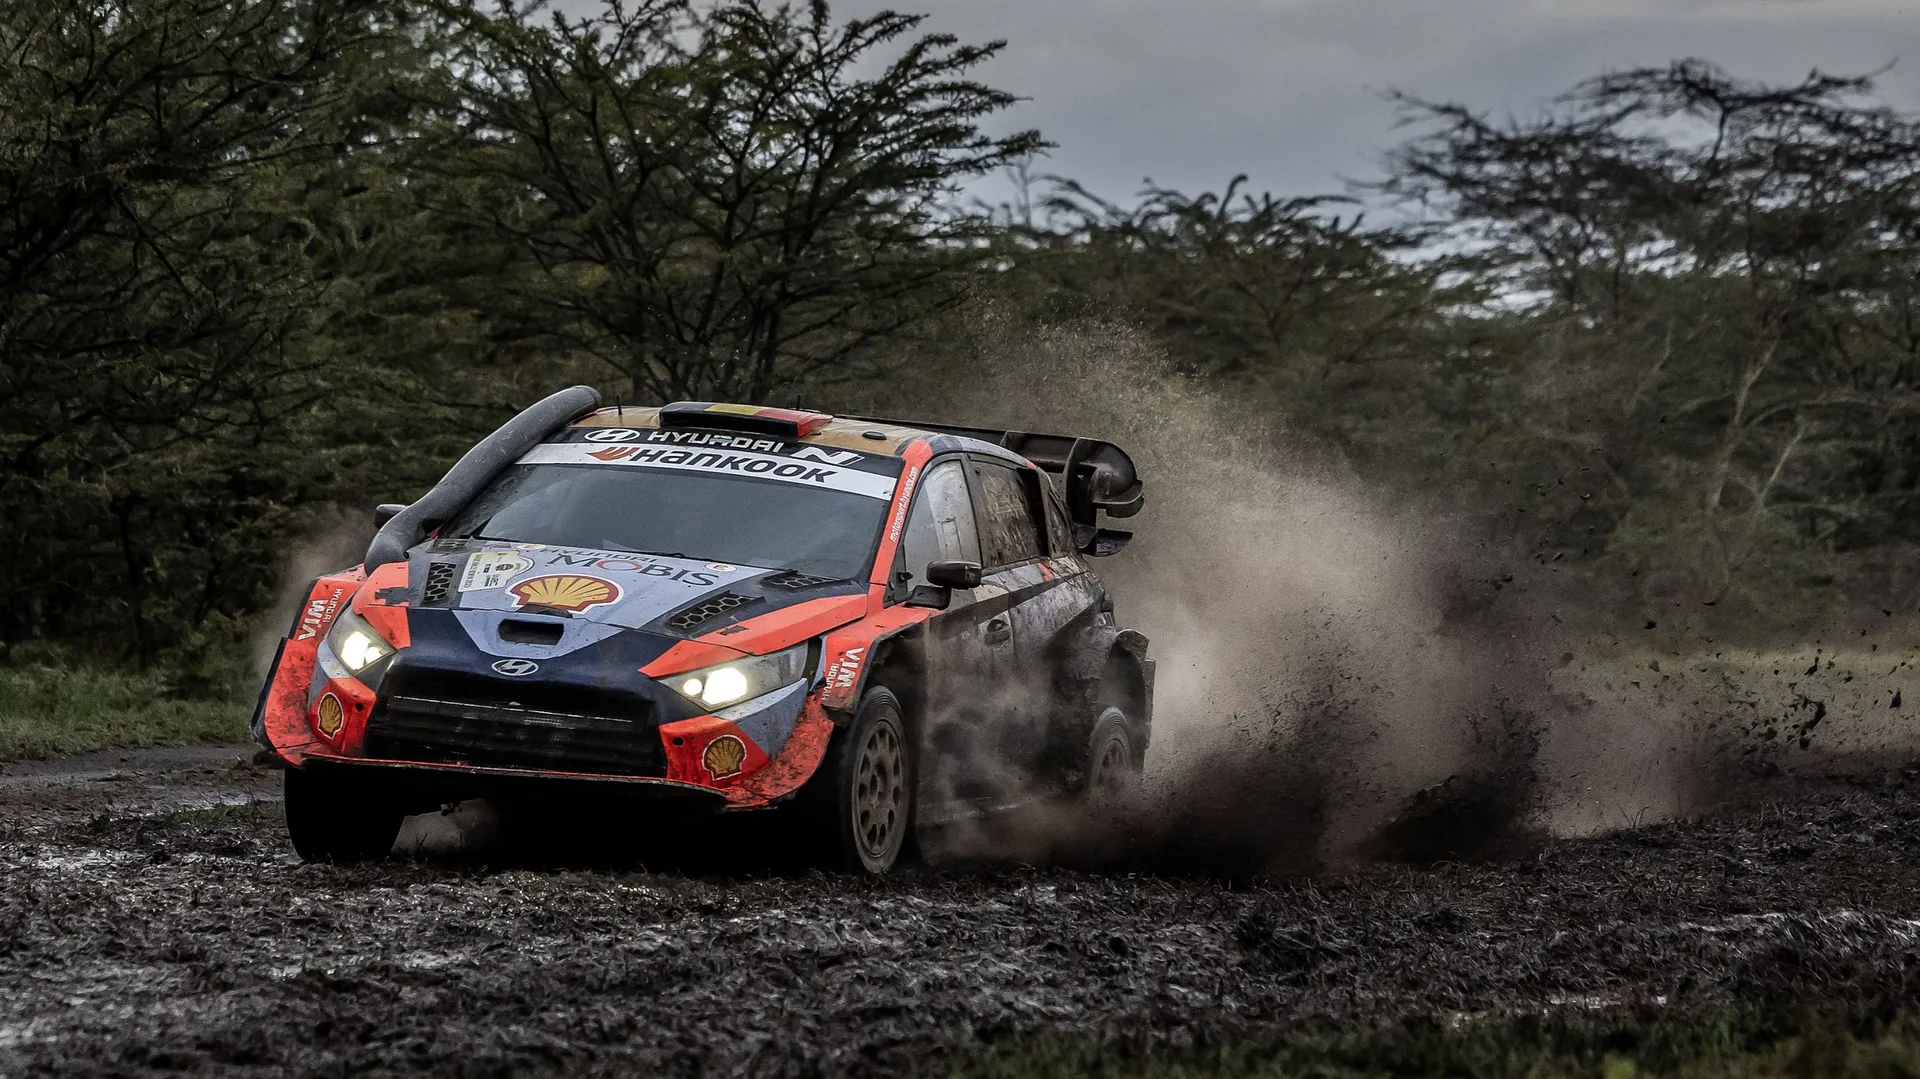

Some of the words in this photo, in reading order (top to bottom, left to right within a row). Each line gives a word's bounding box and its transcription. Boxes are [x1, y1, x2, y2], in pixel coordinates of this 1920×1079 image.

[647, 431, 784, 452] HYUNDAI
[539, 549, 657, 562] HYUNDAI
[546, 553, 719, 586] MOBIS
[323, 588, 343, 622] HYUNDAI
[821, 663, 839, 700] HYUNDAI
